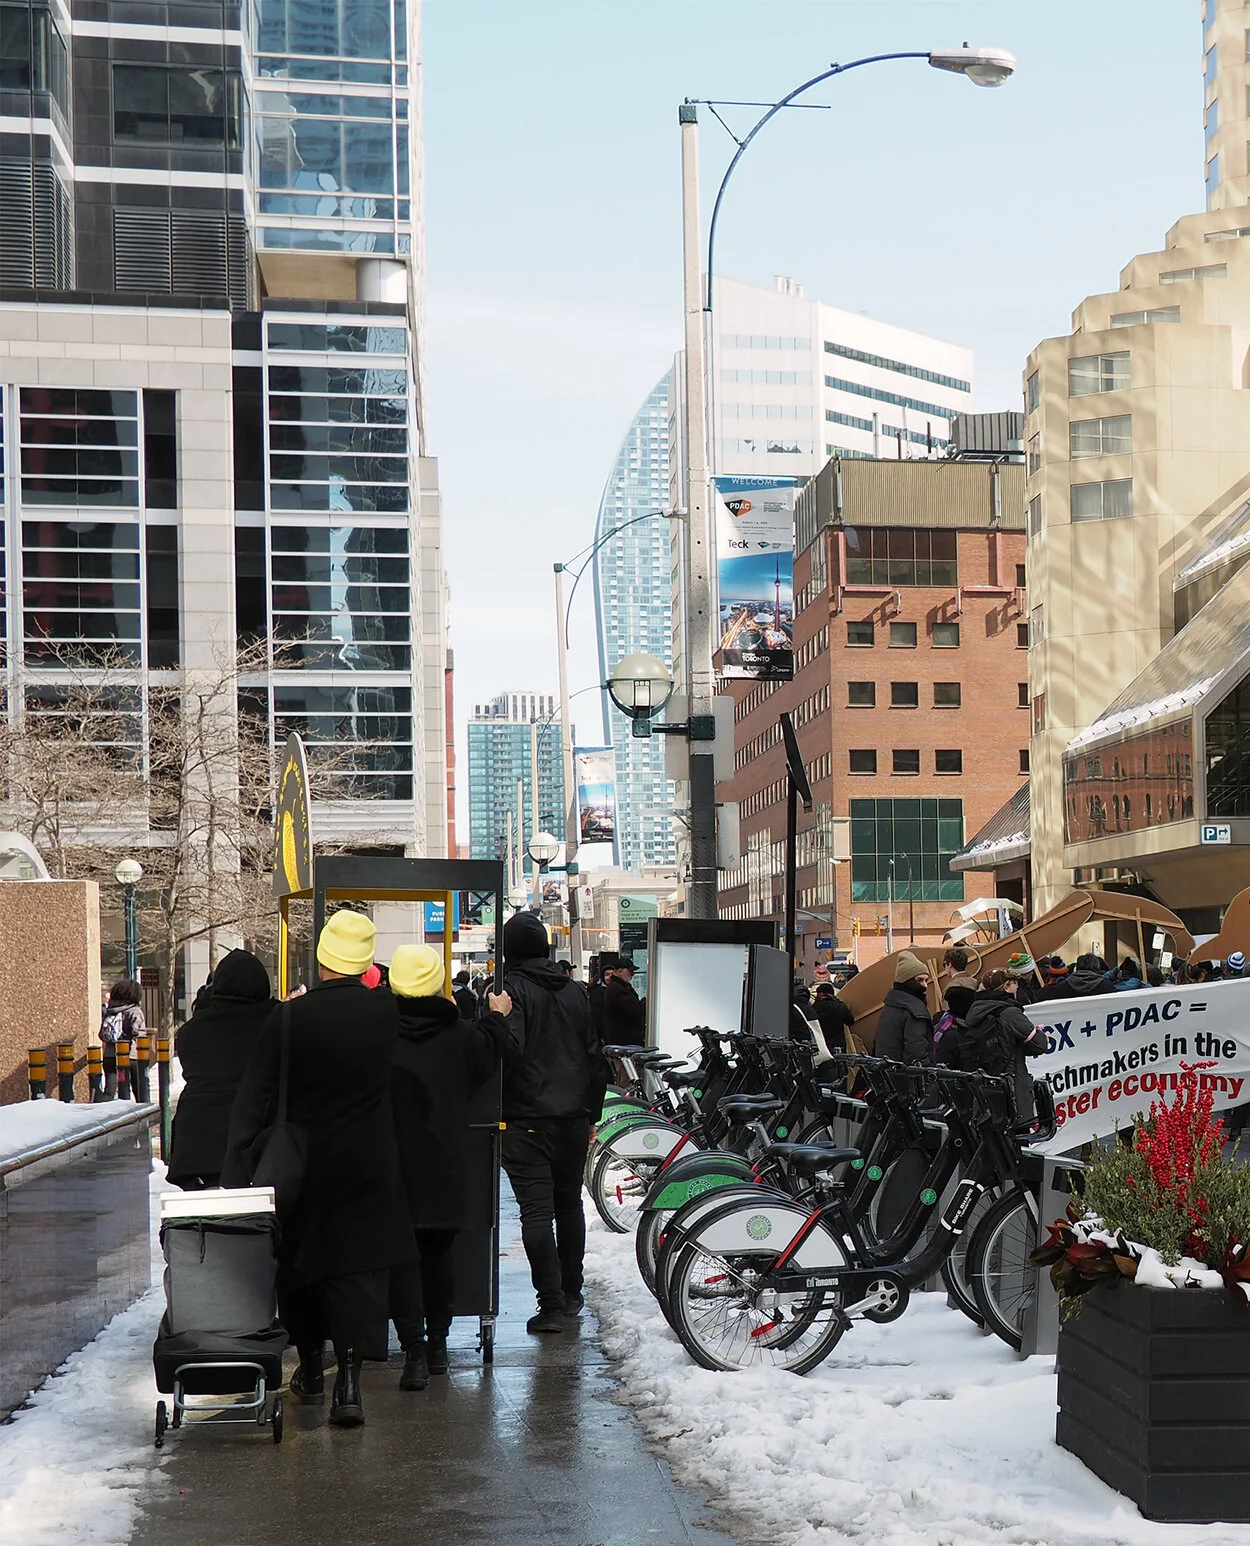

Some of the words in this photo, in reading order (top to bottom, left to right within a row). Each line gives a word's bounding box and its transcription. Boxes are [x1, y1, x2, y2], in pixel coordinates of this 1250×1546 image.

[732, 477, 778, 486] WELCOME
[728, 539, 749, 549] Teck
[1206, 828, 1215, 840] P
[1035, 1020, 1075, 1057] SX
[1080, 1020, 1097, 1038] +
[1106, 1000, 1182, 1037] PDAC
[1189, 1002, 1208, 1012] =
[1045, 1042, 1159, 1094] tchmakers
[1164, 1033, 1187, 1057] in
[1195, 1032, 1237, 1059] the
[1055, 1086, 1103, 1125] ster
[951, 1209, 962, 1224] BIKE
